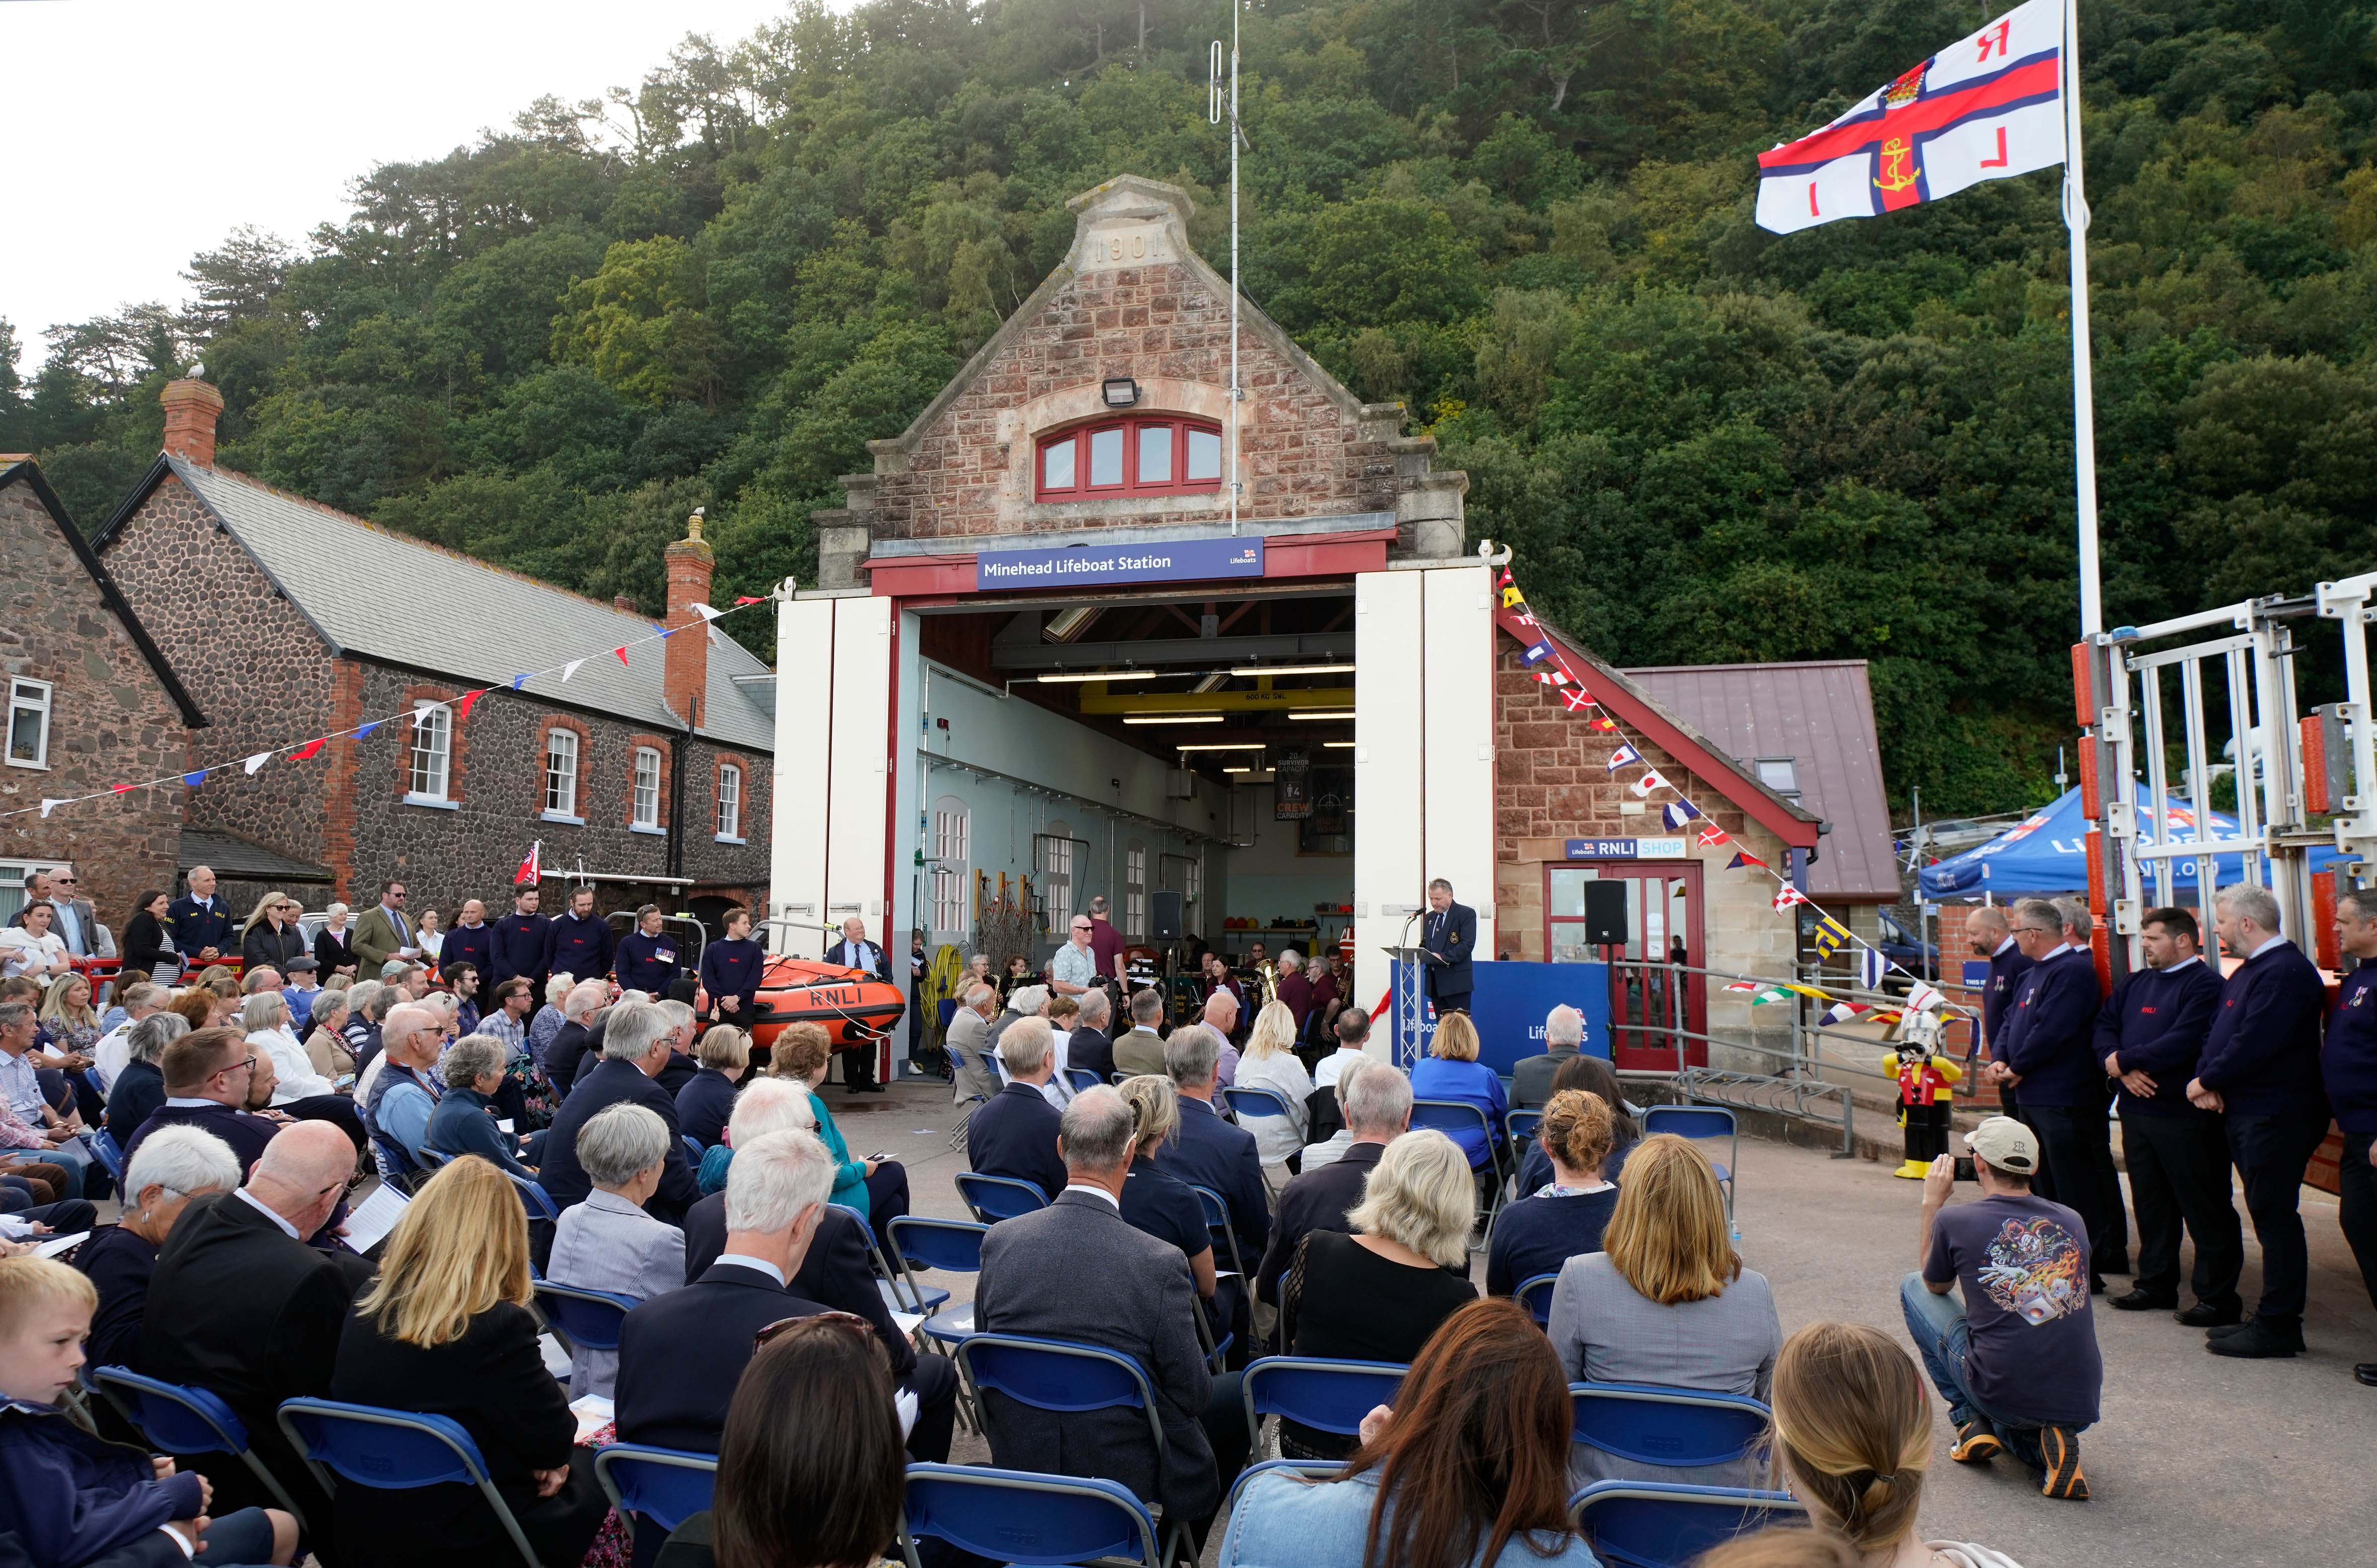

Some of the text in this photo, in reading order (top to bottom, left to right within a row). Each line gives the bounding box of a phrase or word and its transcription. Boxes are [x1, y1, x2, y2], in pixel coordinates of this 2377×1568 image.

[984, 555, 1171, 577] Minehead Lifeboat Station
[1277, 803, 1309, 812] CREW
[1599, 842, 1634, 854] RNLI
[1642, 842, 1682, 854] SHOP
[810, 988, 862, 1006] RNLI
